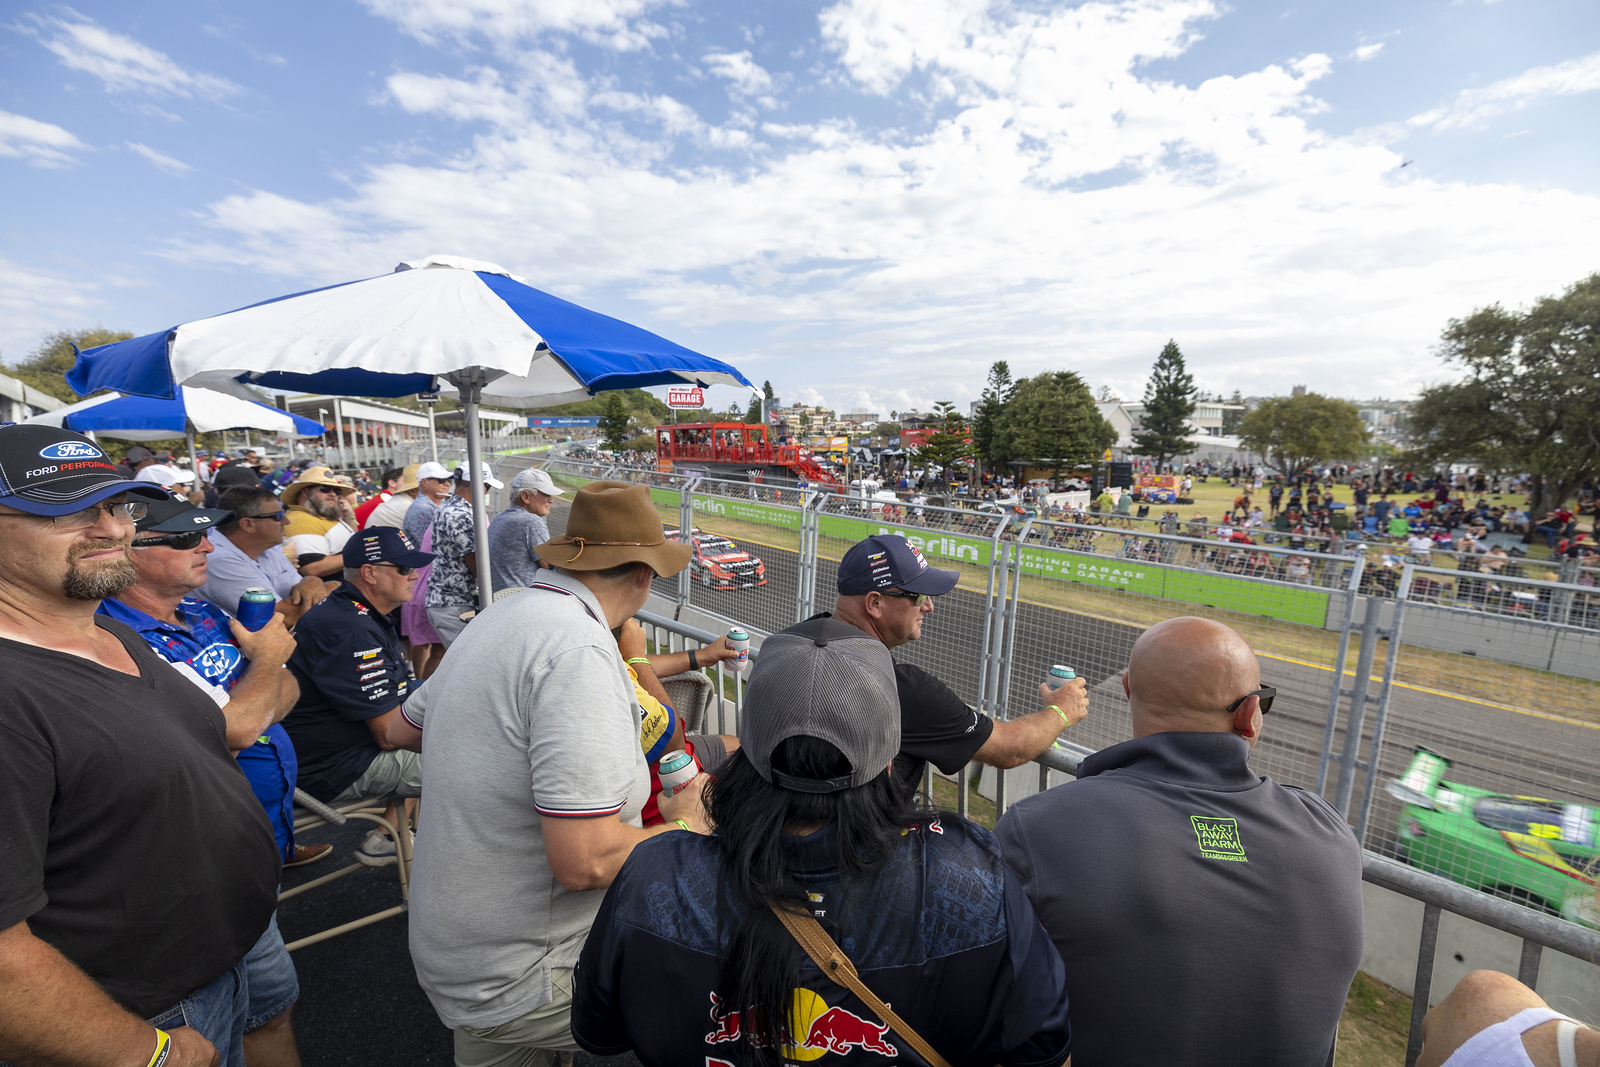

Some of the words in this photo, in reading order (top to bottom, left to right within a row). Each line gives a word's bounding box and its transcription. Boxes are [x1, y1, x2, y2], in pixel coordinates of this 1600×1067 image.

[670, 394, 700, 402] GARAGE
[57, 443, 96, 457] Ford
[25, 465, 58, 479] FORD
[60, 461, 118, 472] PERFORMANC
[692, 499, 726, 514] erlin
[731, 505, 766, 515] POWERING
[768, 511, 797, 521] GARAGE
[1060, 567, 1069, 575] &
[1076, 570, 1129, 585] GATES
[1077, 563, 1146, 580] GARAGE
[360, 669, 386, 680] ACDelco
[1197, 822, 1234, 832] BLAST
[1202, 830, 1233, 840] AWAY
[1202, 838, 1238, 849] HARM
